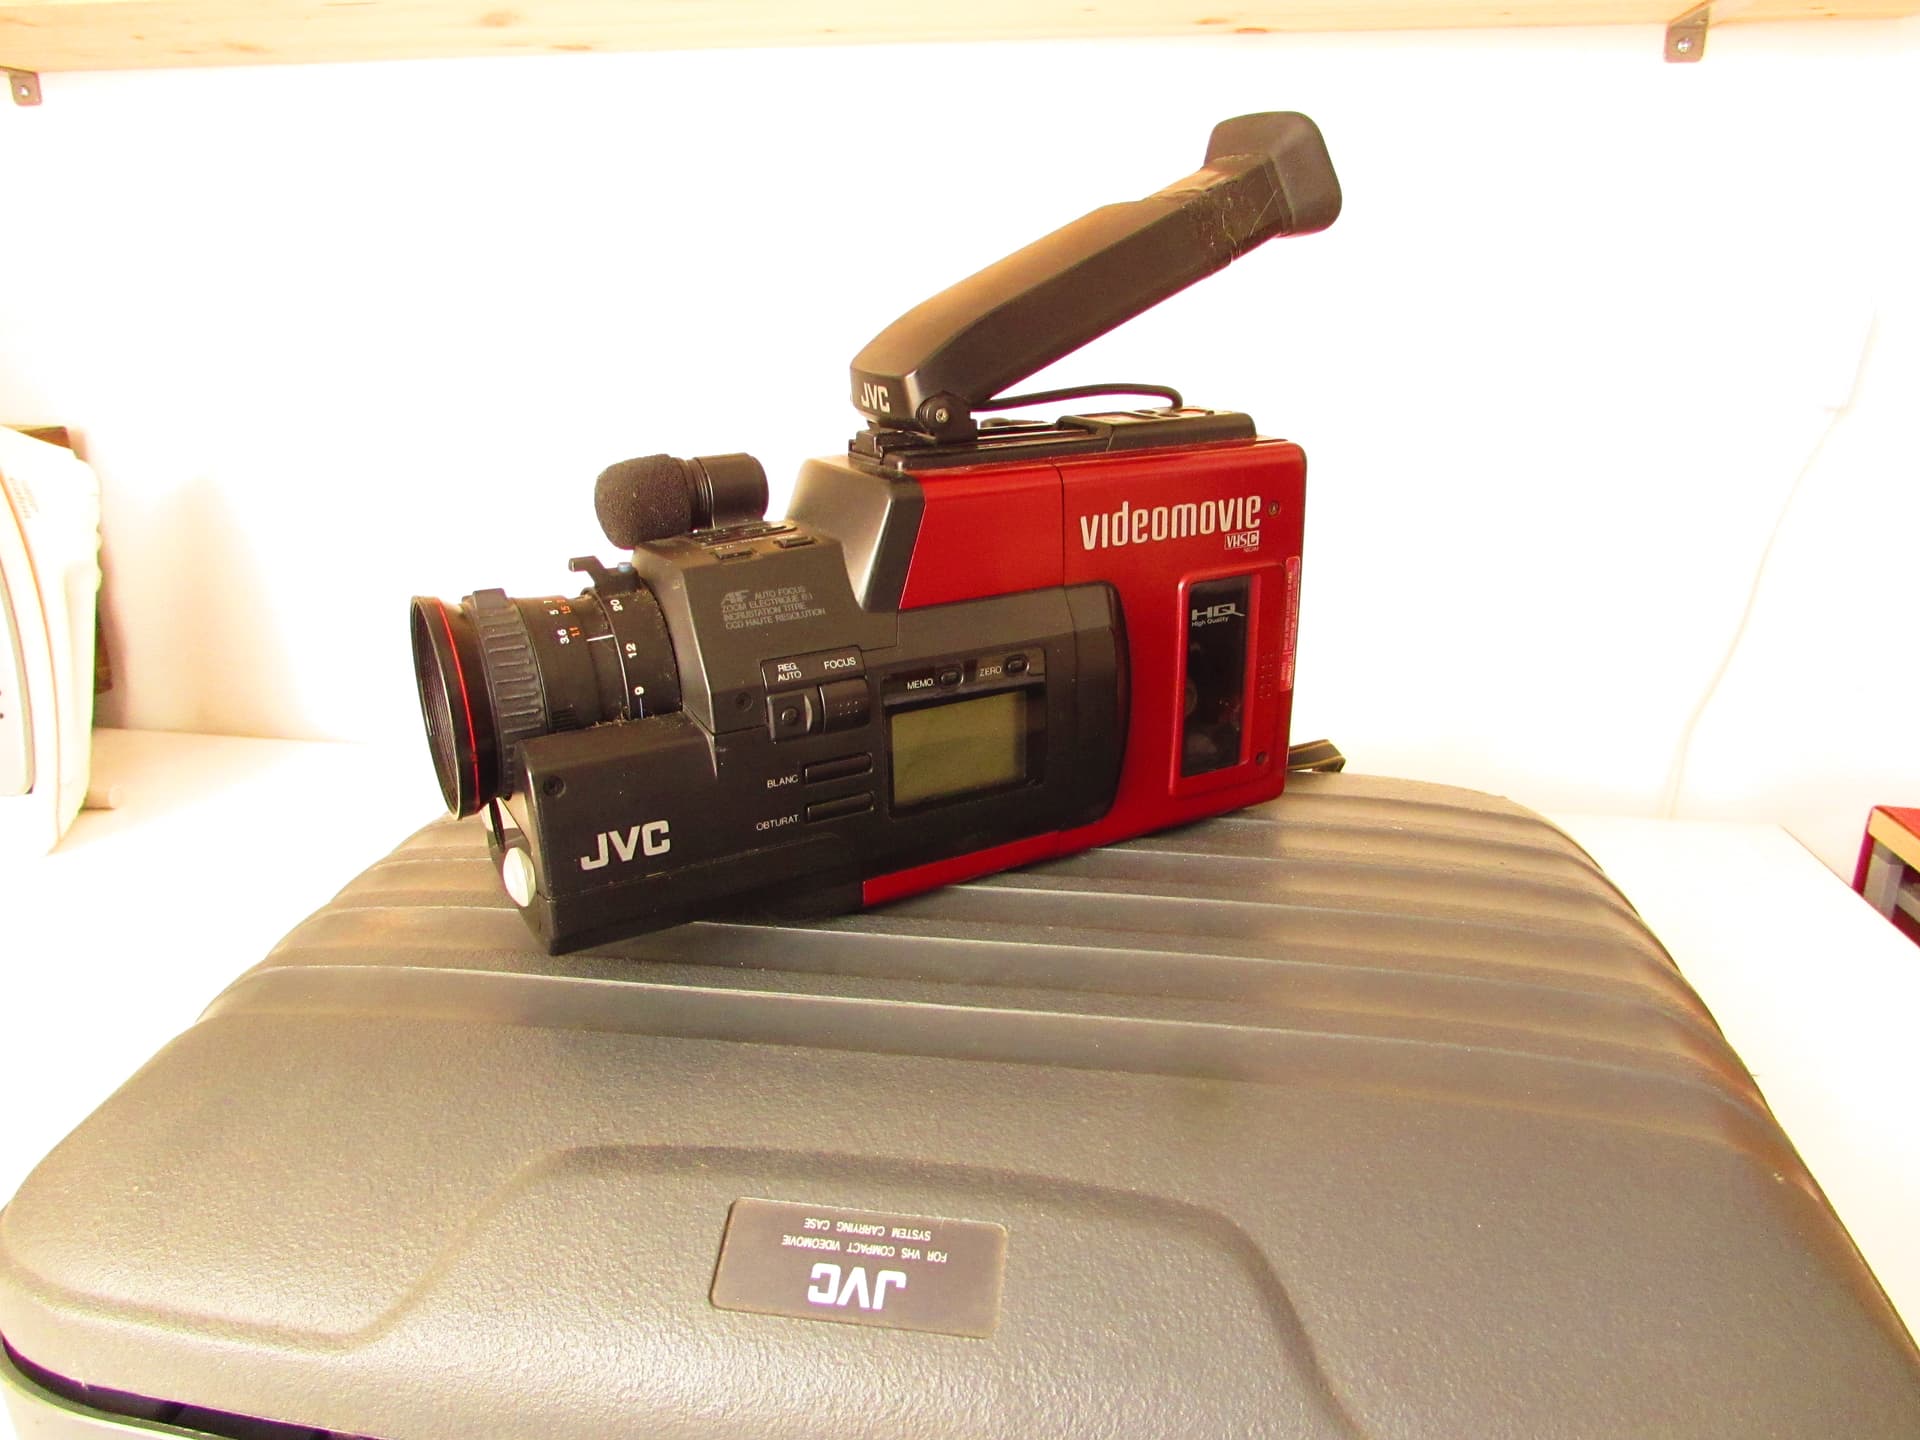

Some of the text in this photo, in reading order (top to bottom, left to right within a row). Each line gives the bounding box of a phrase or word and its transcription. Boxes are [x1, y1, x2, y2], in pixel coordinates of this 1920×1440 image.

[861, 382, 890, 413] JVC
[755, 586, 806, 600] AUTO FOCUS
[610, 599, 623, 612] 20
[1192, 603, 1245, 621] HQ
[746, 615, 773, 627] HAUTE
[775, 608, 826, 622] RESOLUTION
[1192, 615, 1229, 628] High Quality
[626, 643, 637, 658] 12
[824, 656, 857, 670] FOCUS
[778, 670, 802, 682] AUTO
[979, 665, 1002, 677] ZERO
[634, 686, 644, 695] 9
[767, 774, 799, 788] BLANC
[581, 820, 671, 871] JVC
[803, 1217, 932, 1242] SYSTEM CARRYING CASE
[782, 1234, 948, 1263] FOR VHS COMPACT VIDEOMOVIE
[808, 1262, 907, 1310] JVC
